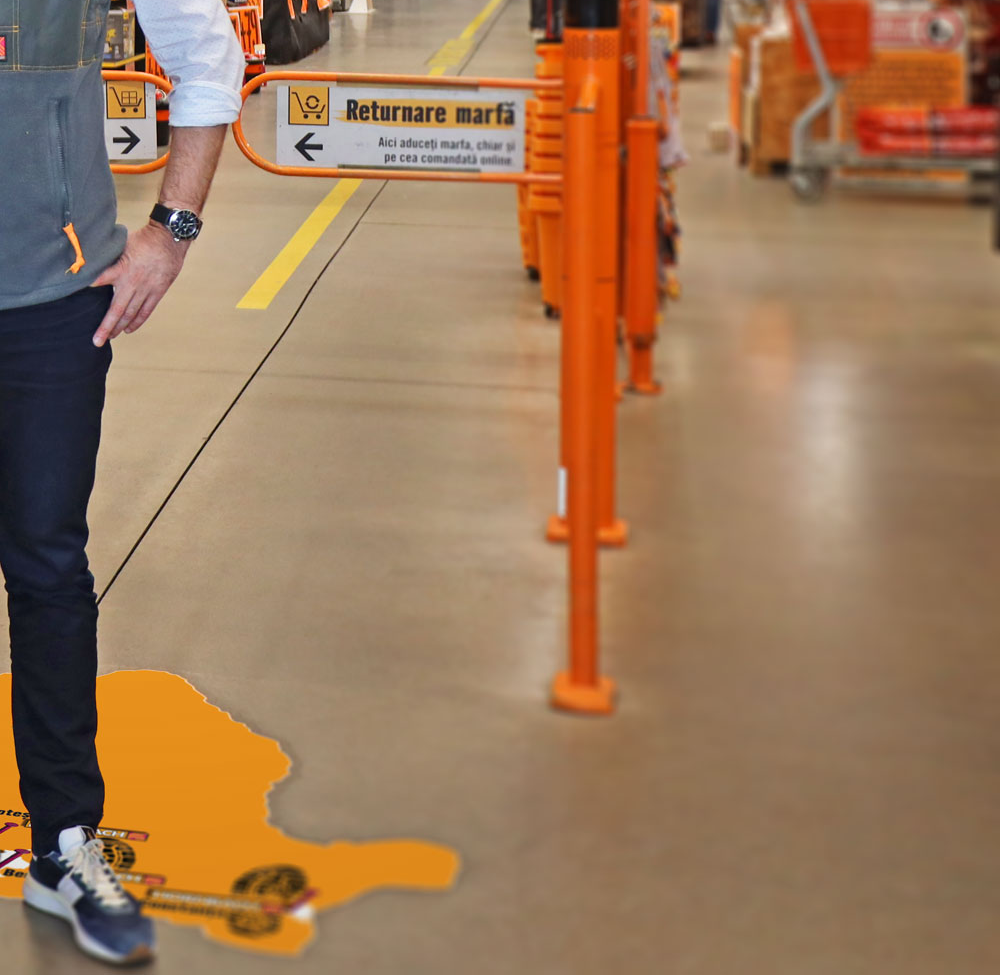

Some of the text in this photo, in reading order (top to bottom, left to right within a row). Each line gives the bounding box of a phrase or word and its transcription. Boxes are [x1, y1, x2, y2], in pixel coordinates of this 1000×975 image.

[346, 98, 517, 126] Returnare marfă
[378, 137, 398, 148] Aici
[399, 137, 438, 151] aduceți
[476, 139, 503, 151] chiar
[384, 153, 397, 164] pe
[400, 153, 418, 163] cea
[420, 153, 478, 165] comandată
